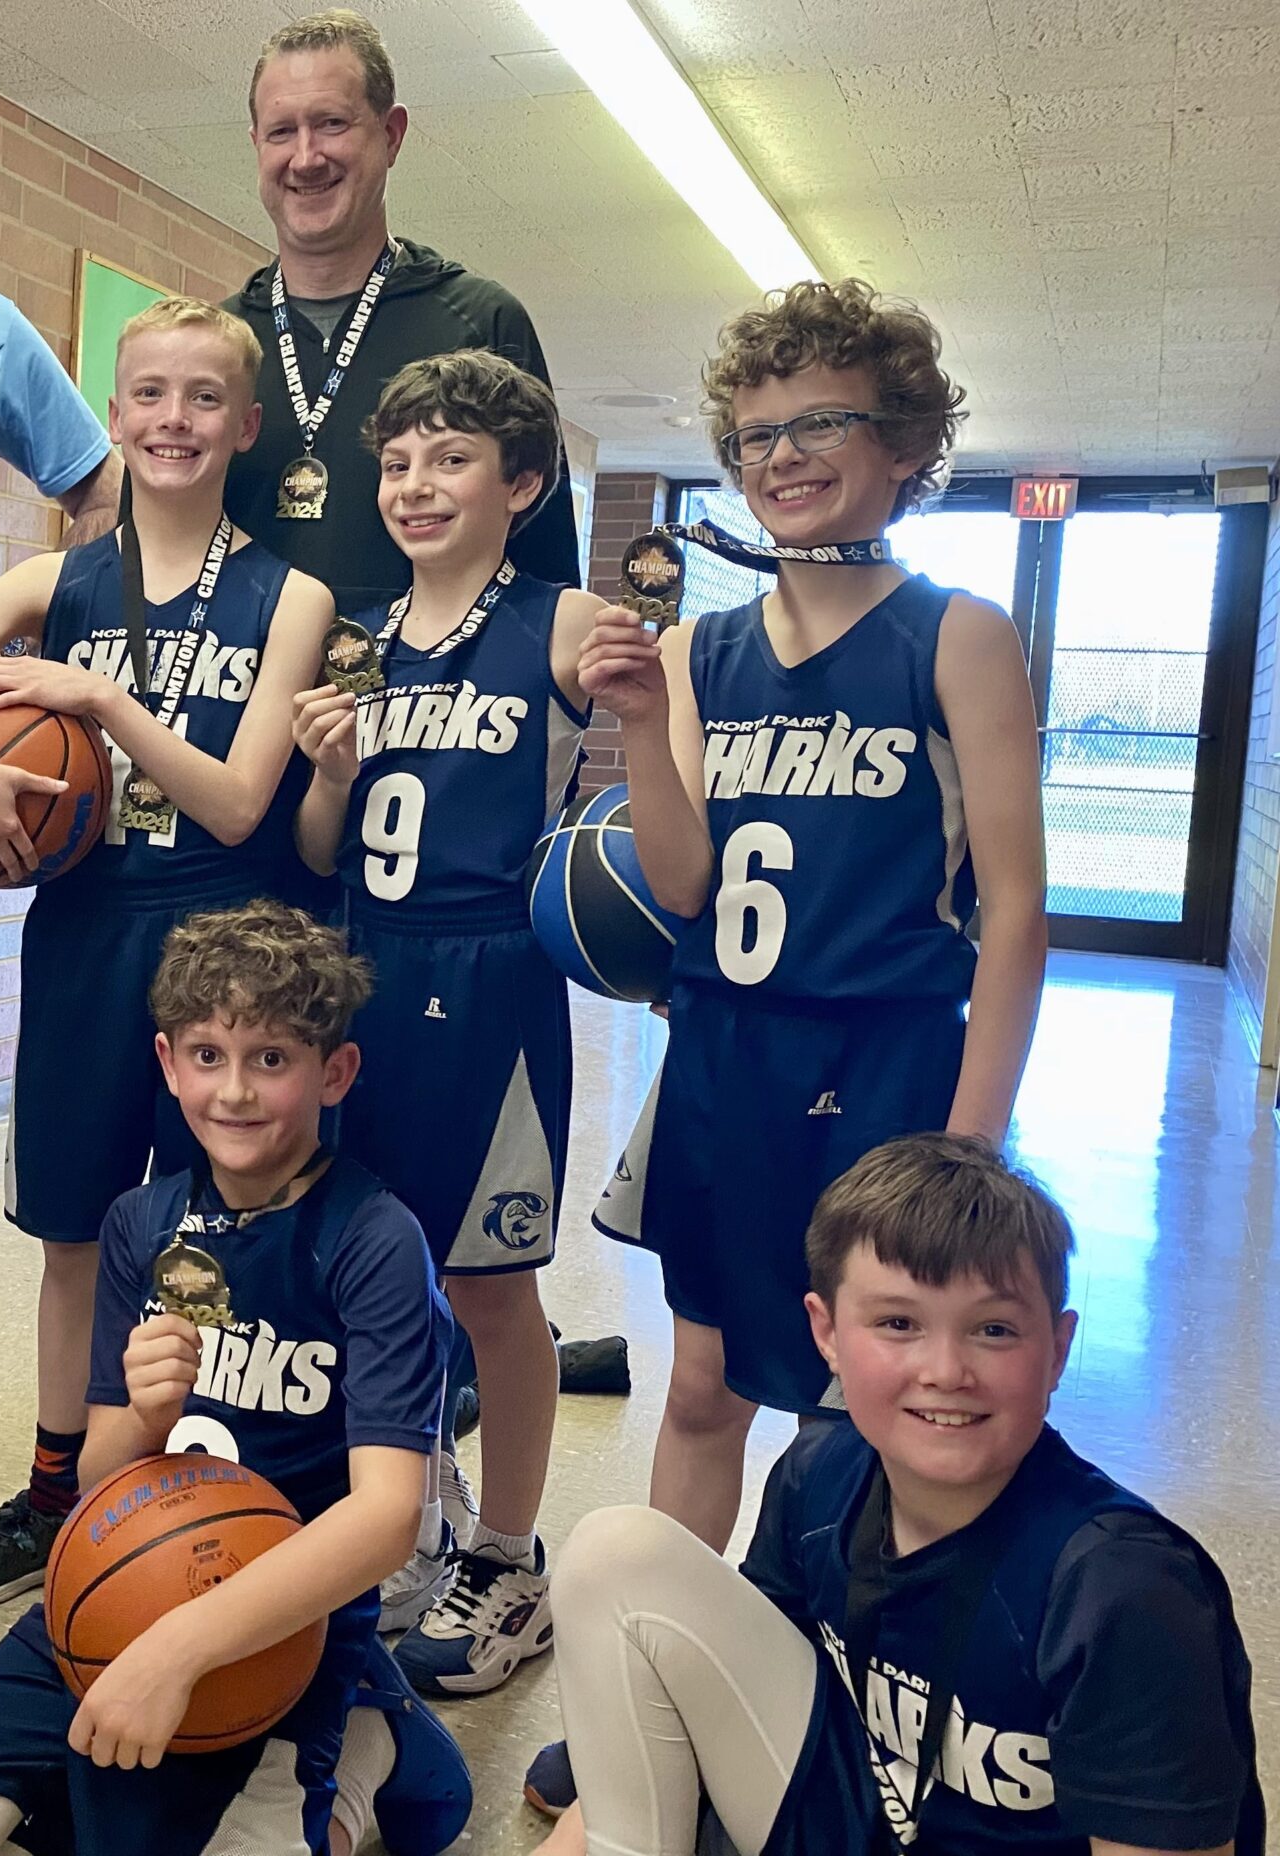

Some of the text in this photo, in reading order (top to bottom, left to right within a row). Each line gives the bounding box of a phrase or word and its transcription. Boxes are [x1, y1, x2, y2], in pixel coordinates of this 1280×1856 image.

[335, 271, 386, 368] CHAMPION
[278, 333, 311, 426] CHAMPION
[285, 475, 323, 488] CHAMPION
[276, 501, 323, 518] 2024
[1017, 482, 1072, 516] EXIT
[627, 559, 680, 577] CHAMPION
[327, 640, 369, 661] CHAMPION
[354, 682, 459, 706] NORTH PARK
[356, 680, 529, 763] HARKS
[771, 714, 831, 728] PARK
[704, 711, 917, 799] HARKS
[117, 807, 170, 834] 2024
[362, 772, 426, 901] 9
[715, 821, 794, 986] 6
